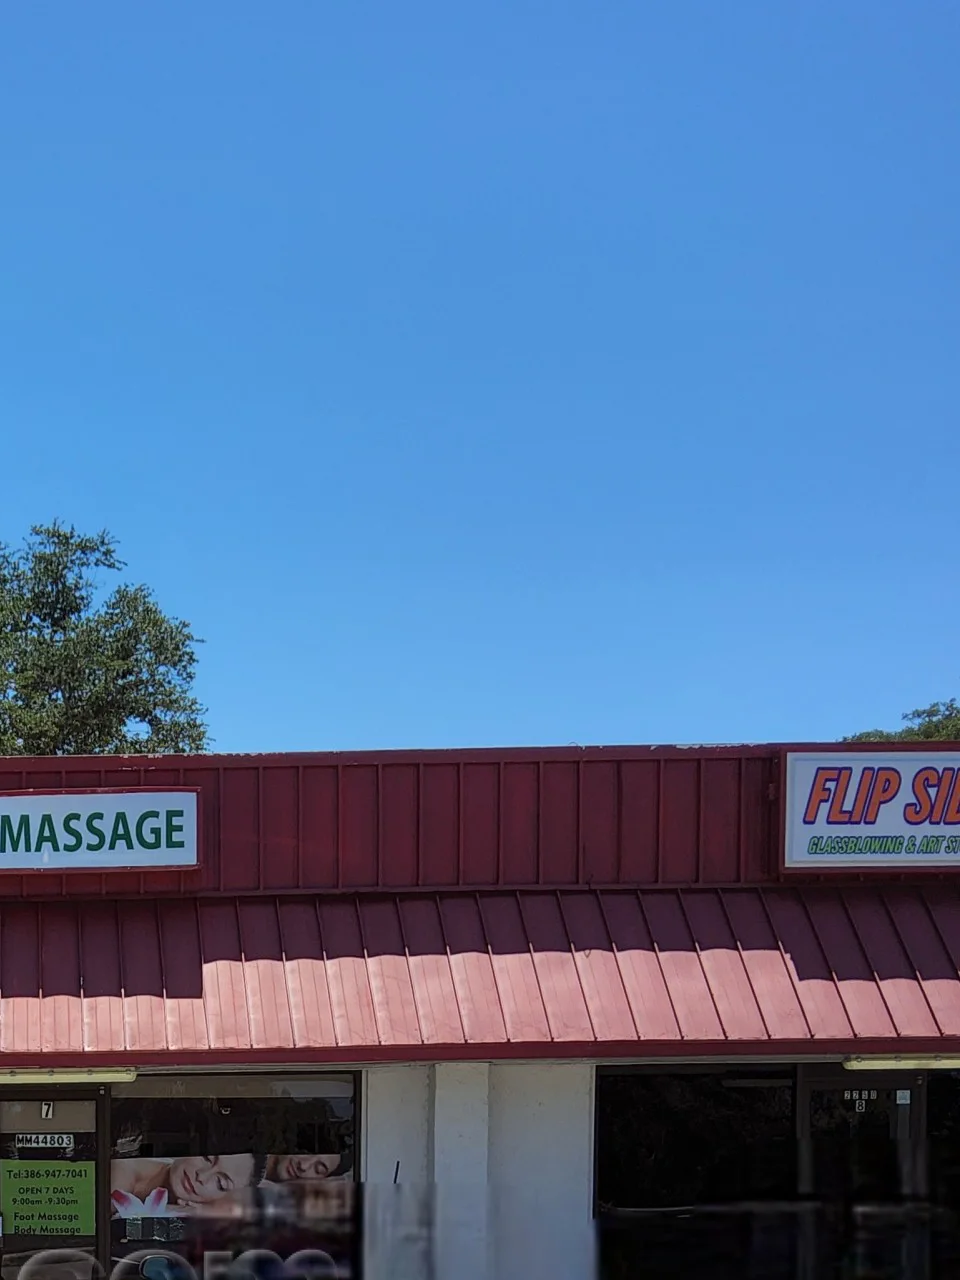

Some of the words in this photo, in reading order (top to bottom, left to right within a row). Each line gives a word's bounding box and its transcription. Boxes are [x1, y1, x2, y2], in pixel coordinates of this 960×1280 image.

[803, 766, 901, 825] FLIP
[0, 810, 185, 854] MASSAGE
[807, 836, 905, 855] GLASSBLOWING
[905, 835, 916, 854] &
[916, 835, 945, 854] ART
[43, 1102, 52, 1118] 7
[857, 1101, 864, 1111] 8
[16, 1135, 73, 1147] MM44803
[7, 1169, 88, 1180] Tel:386-947-7041
[18, 1187, 43, 1195] OPEN
[52, 1187, 75, 1195] DAYS
[13, 1212, 35, 1221] Foot
[38, 1211, 79, 1223] Massage
[14, 1225, 37, 1235] Body
[38, 1225, 81, 1236] Massage
